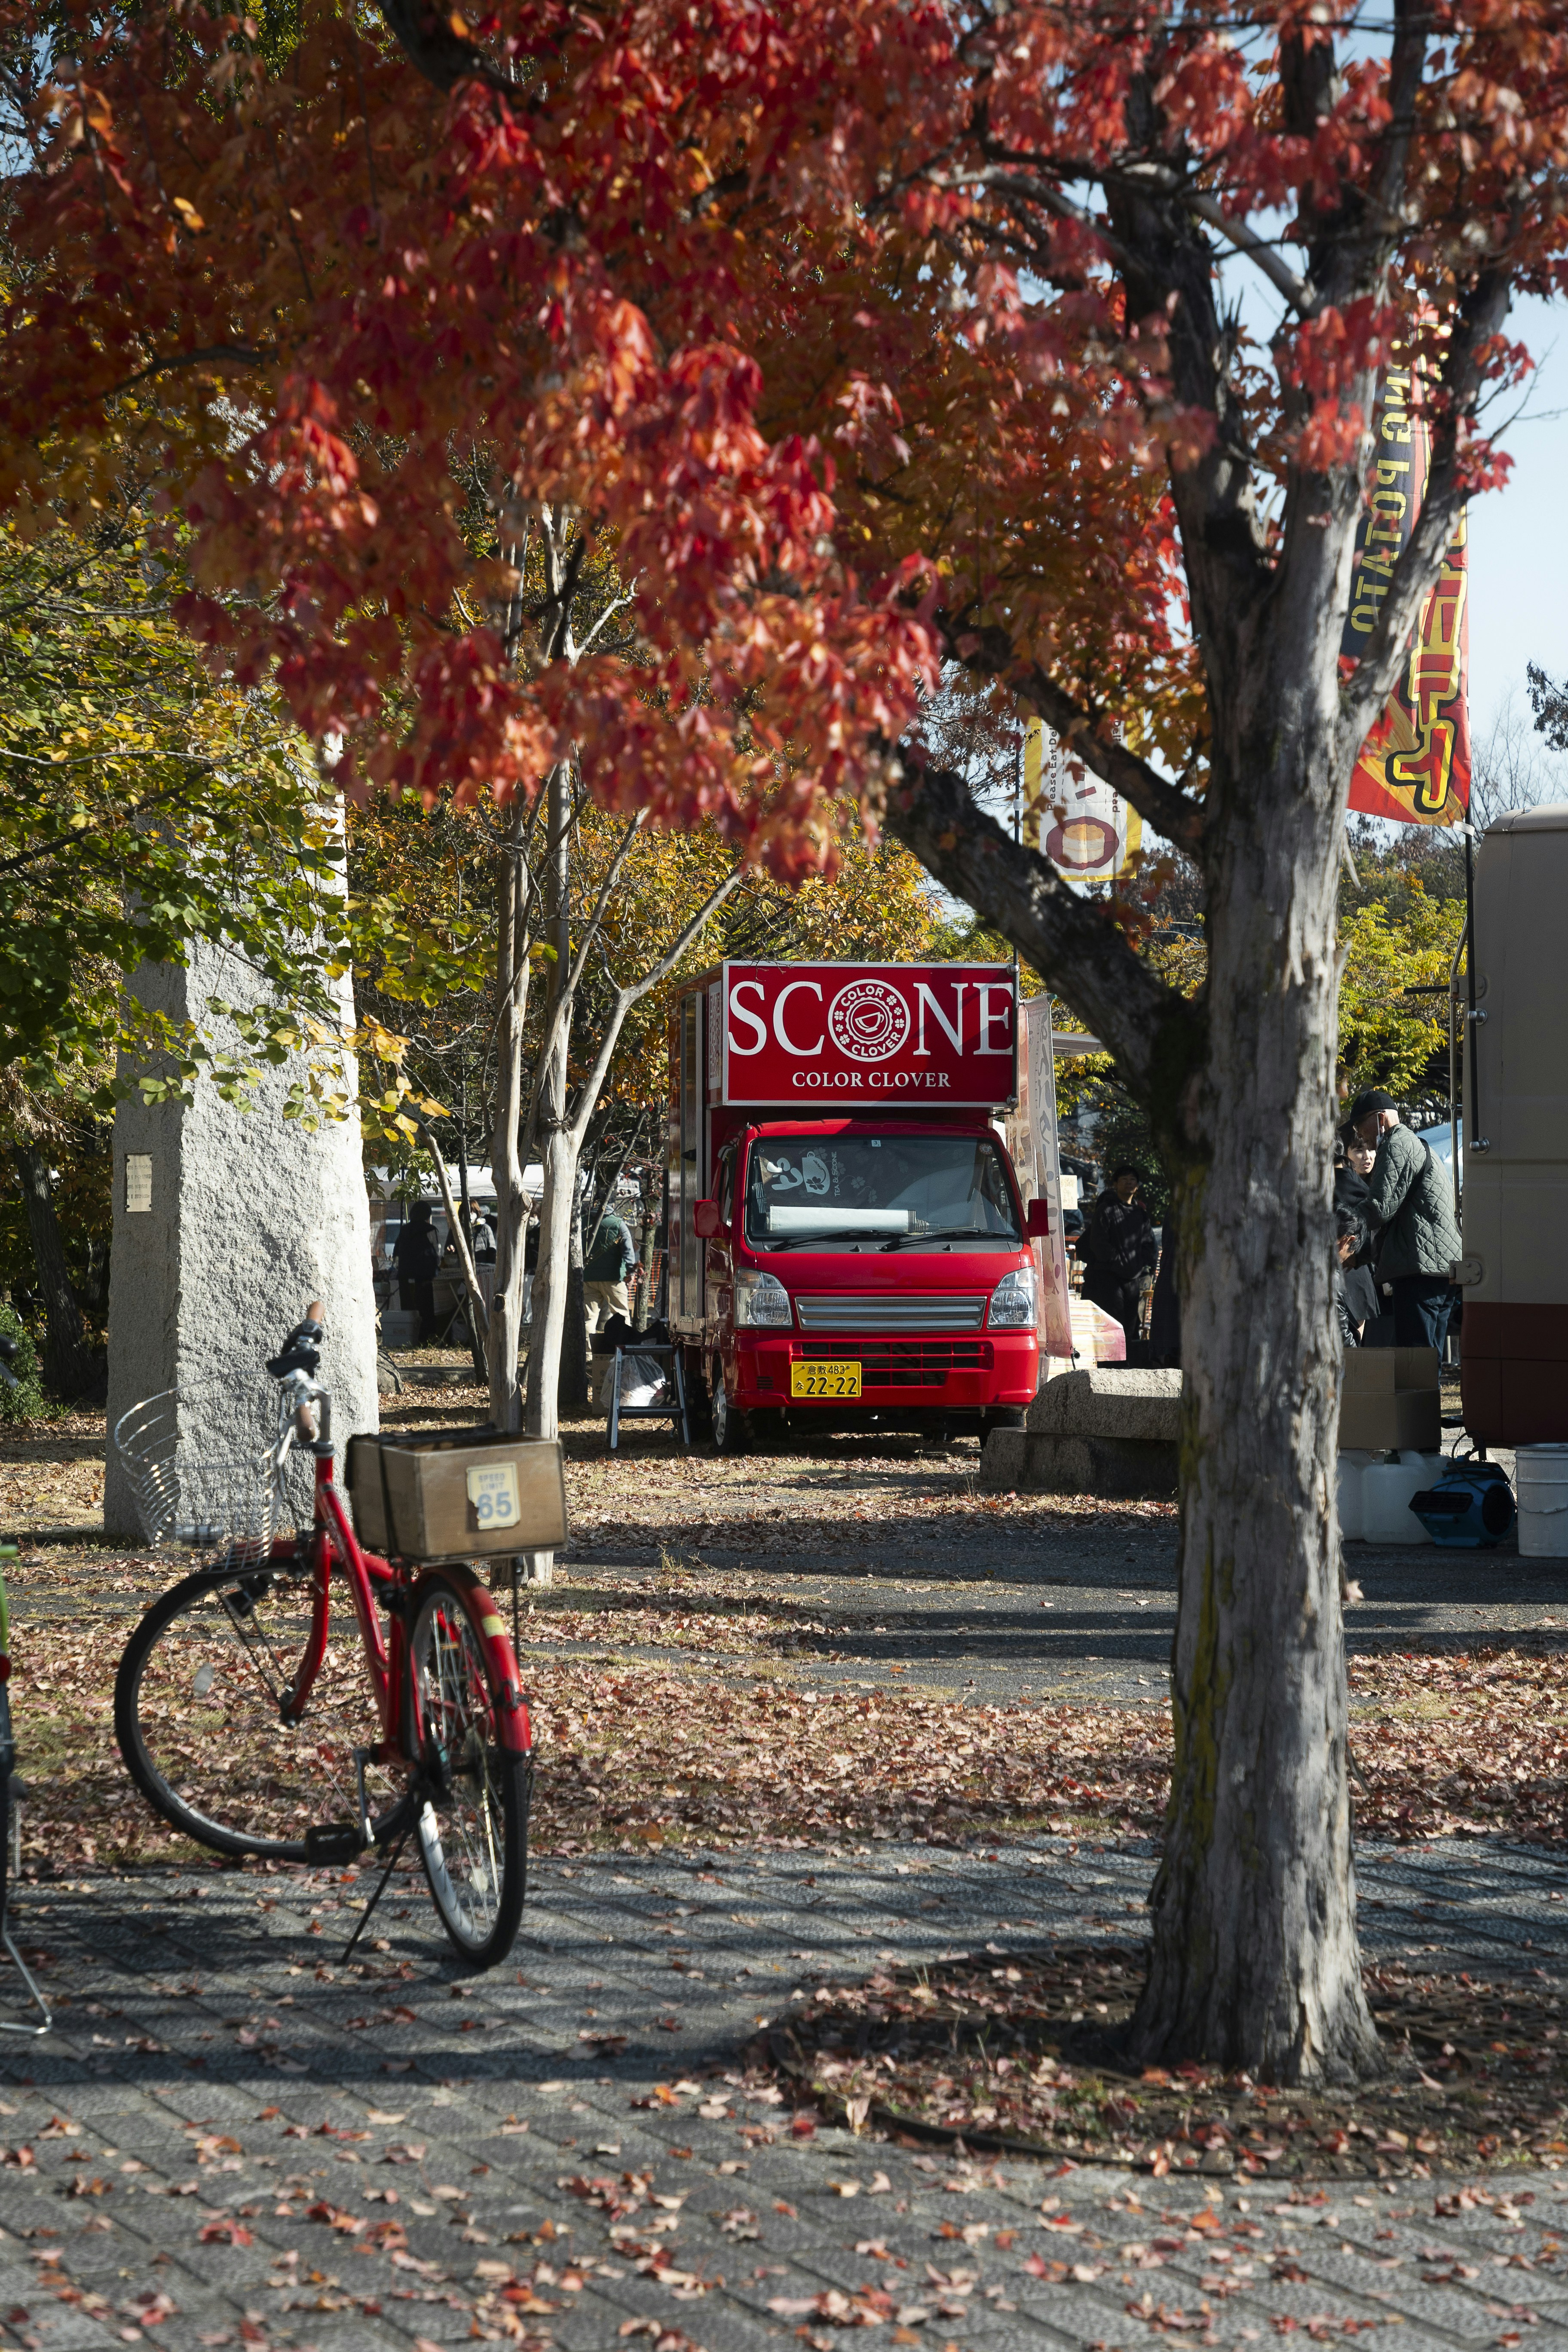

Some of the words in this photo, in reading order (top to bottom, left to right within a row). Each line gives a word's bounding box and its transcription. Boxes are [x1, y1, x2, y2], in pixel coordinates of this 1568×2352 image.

[1049, 727, 1057, 745] Del
[1048, 749, 1057, 769] Eat
[1046, 772, 1057, 811] Please
[841, 985, 884, 1007] COLOR
[728, 979, 1014, 1062] SCONE
[851, 1032, 901, 1057] CLOVER
[792, 1072, 864, 1087] COLOR
[868, 1072, 951, 1087] CLOVER
[796, 1380, 805, 1390] な
[806, 1377, 858, 1395] 22-22
[478, 1473, 505, 1482] SPEED
[477, 1491, 512, 1520] 65
